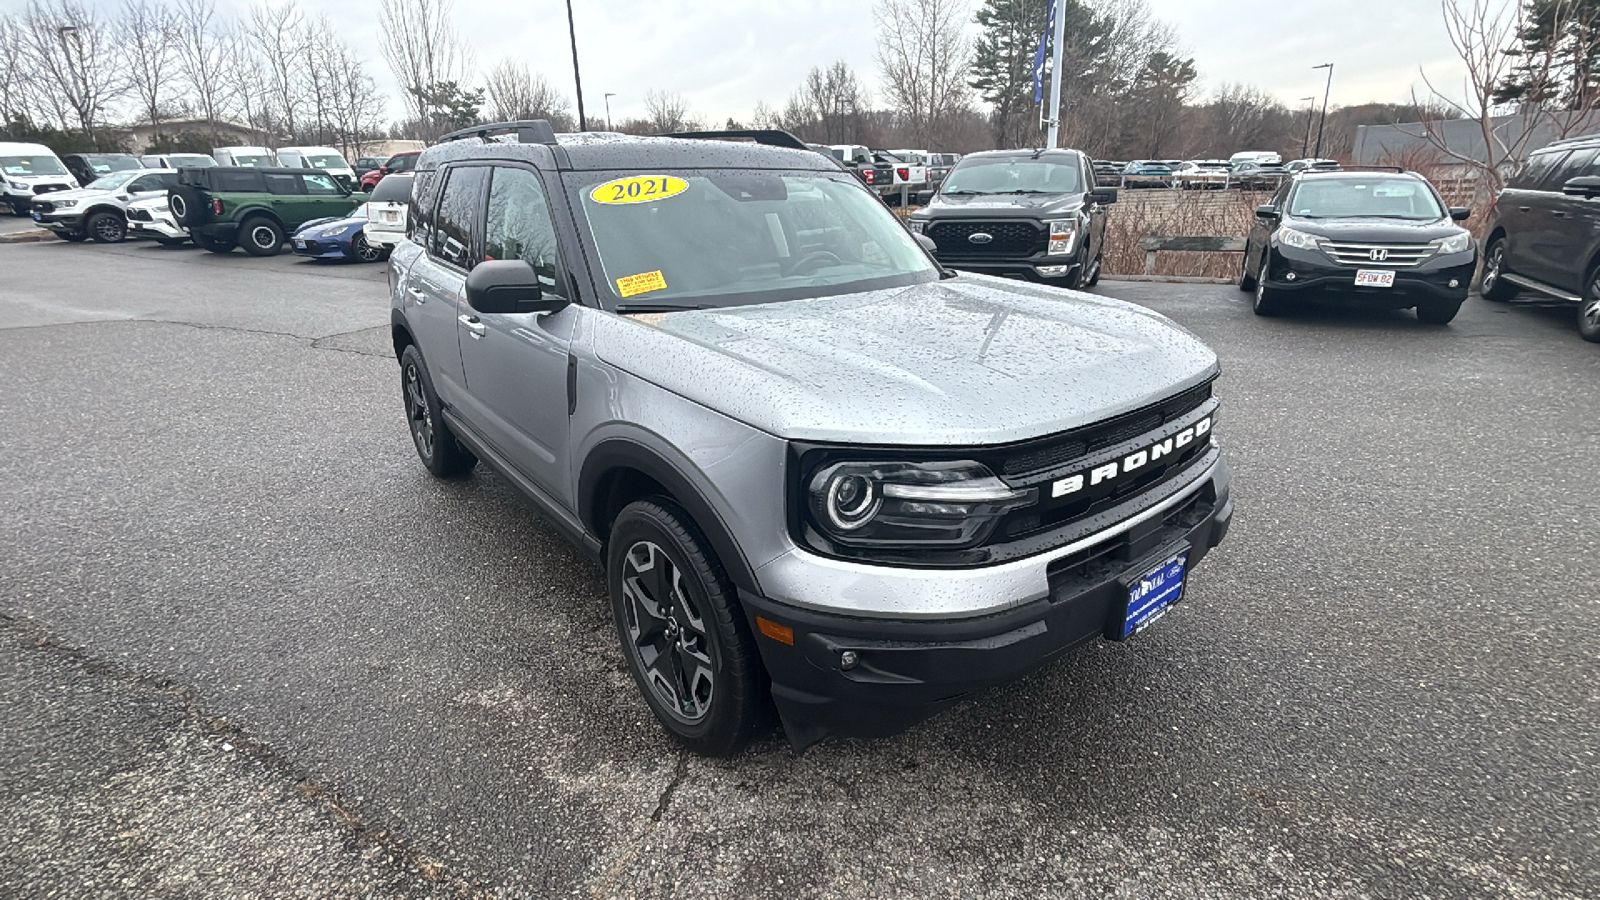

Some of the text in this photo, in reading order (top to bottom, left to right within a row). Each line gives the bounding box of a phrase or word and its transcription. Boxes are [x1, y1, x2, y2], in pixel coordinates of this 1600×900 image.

[611, 178, 669, 200] 2021
[1380, 274, 1393, 284] 82
[1052, 417, 1211, 498] BRONCO
